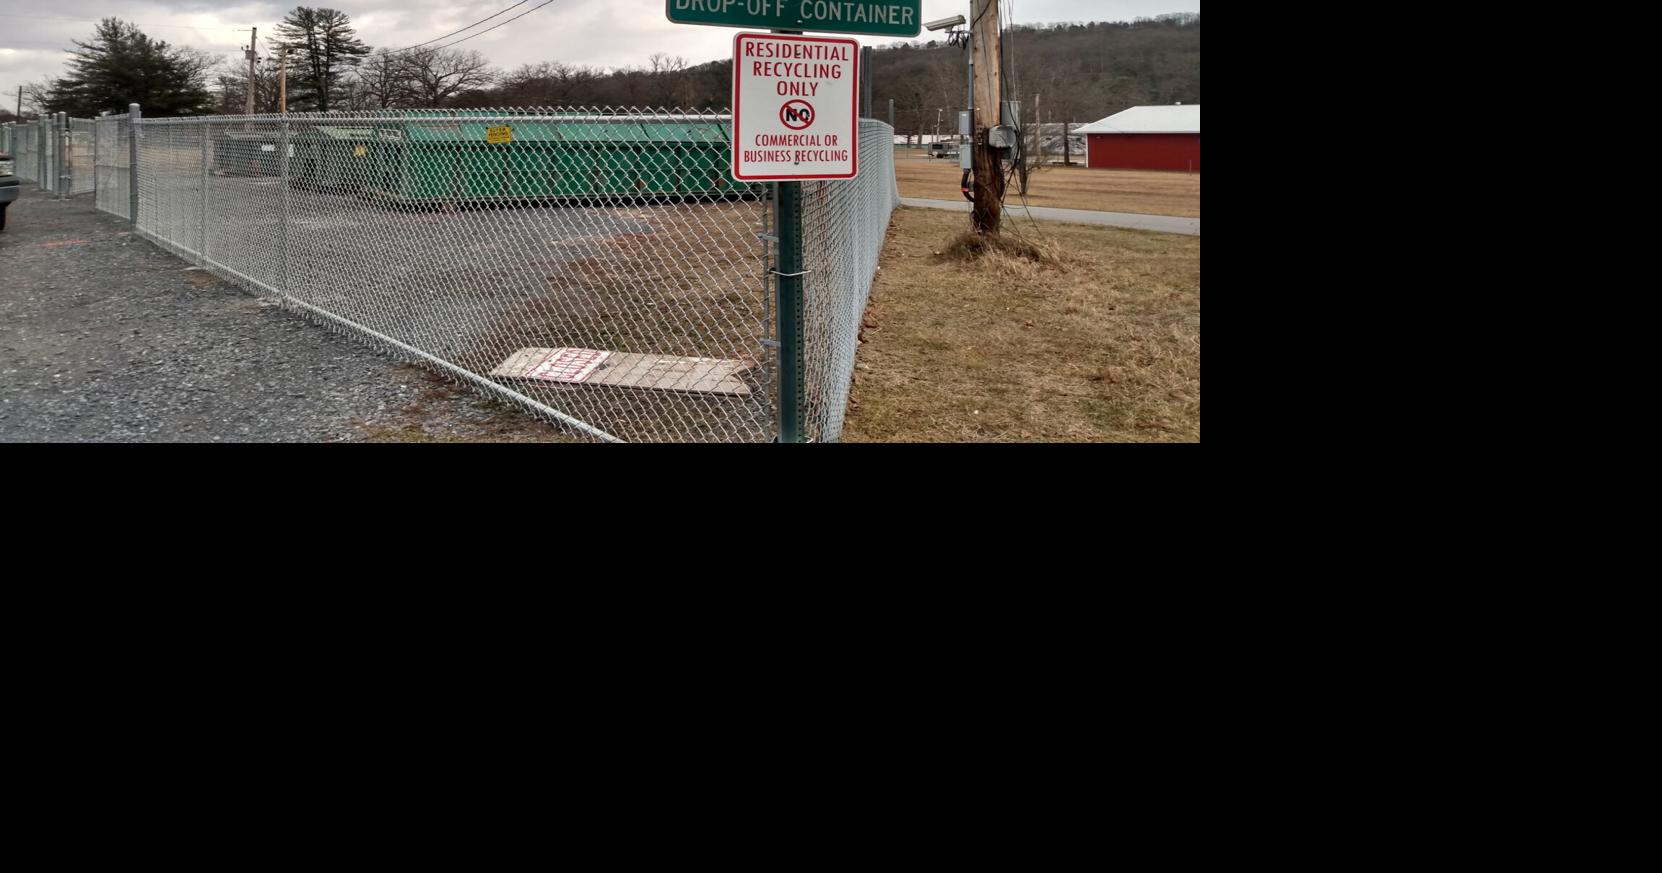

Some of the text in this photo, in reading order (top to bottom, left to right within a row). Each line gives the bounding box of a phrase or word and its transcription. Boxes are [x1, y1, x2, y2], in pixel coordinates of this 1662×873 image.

[800, 0, 914, 25] CONTAINER
[745, 41, 848, 61] RESIDENTIAL
[753, 61, 841, 79] RECYCLING
[777, 81, 819, 97] ONLY
[785, 108, 810, 122] NO
[755, 134, 838, 147] COMMERCIAL OR
[744, 150, 848, 163] BUSINESS RECYCLING
